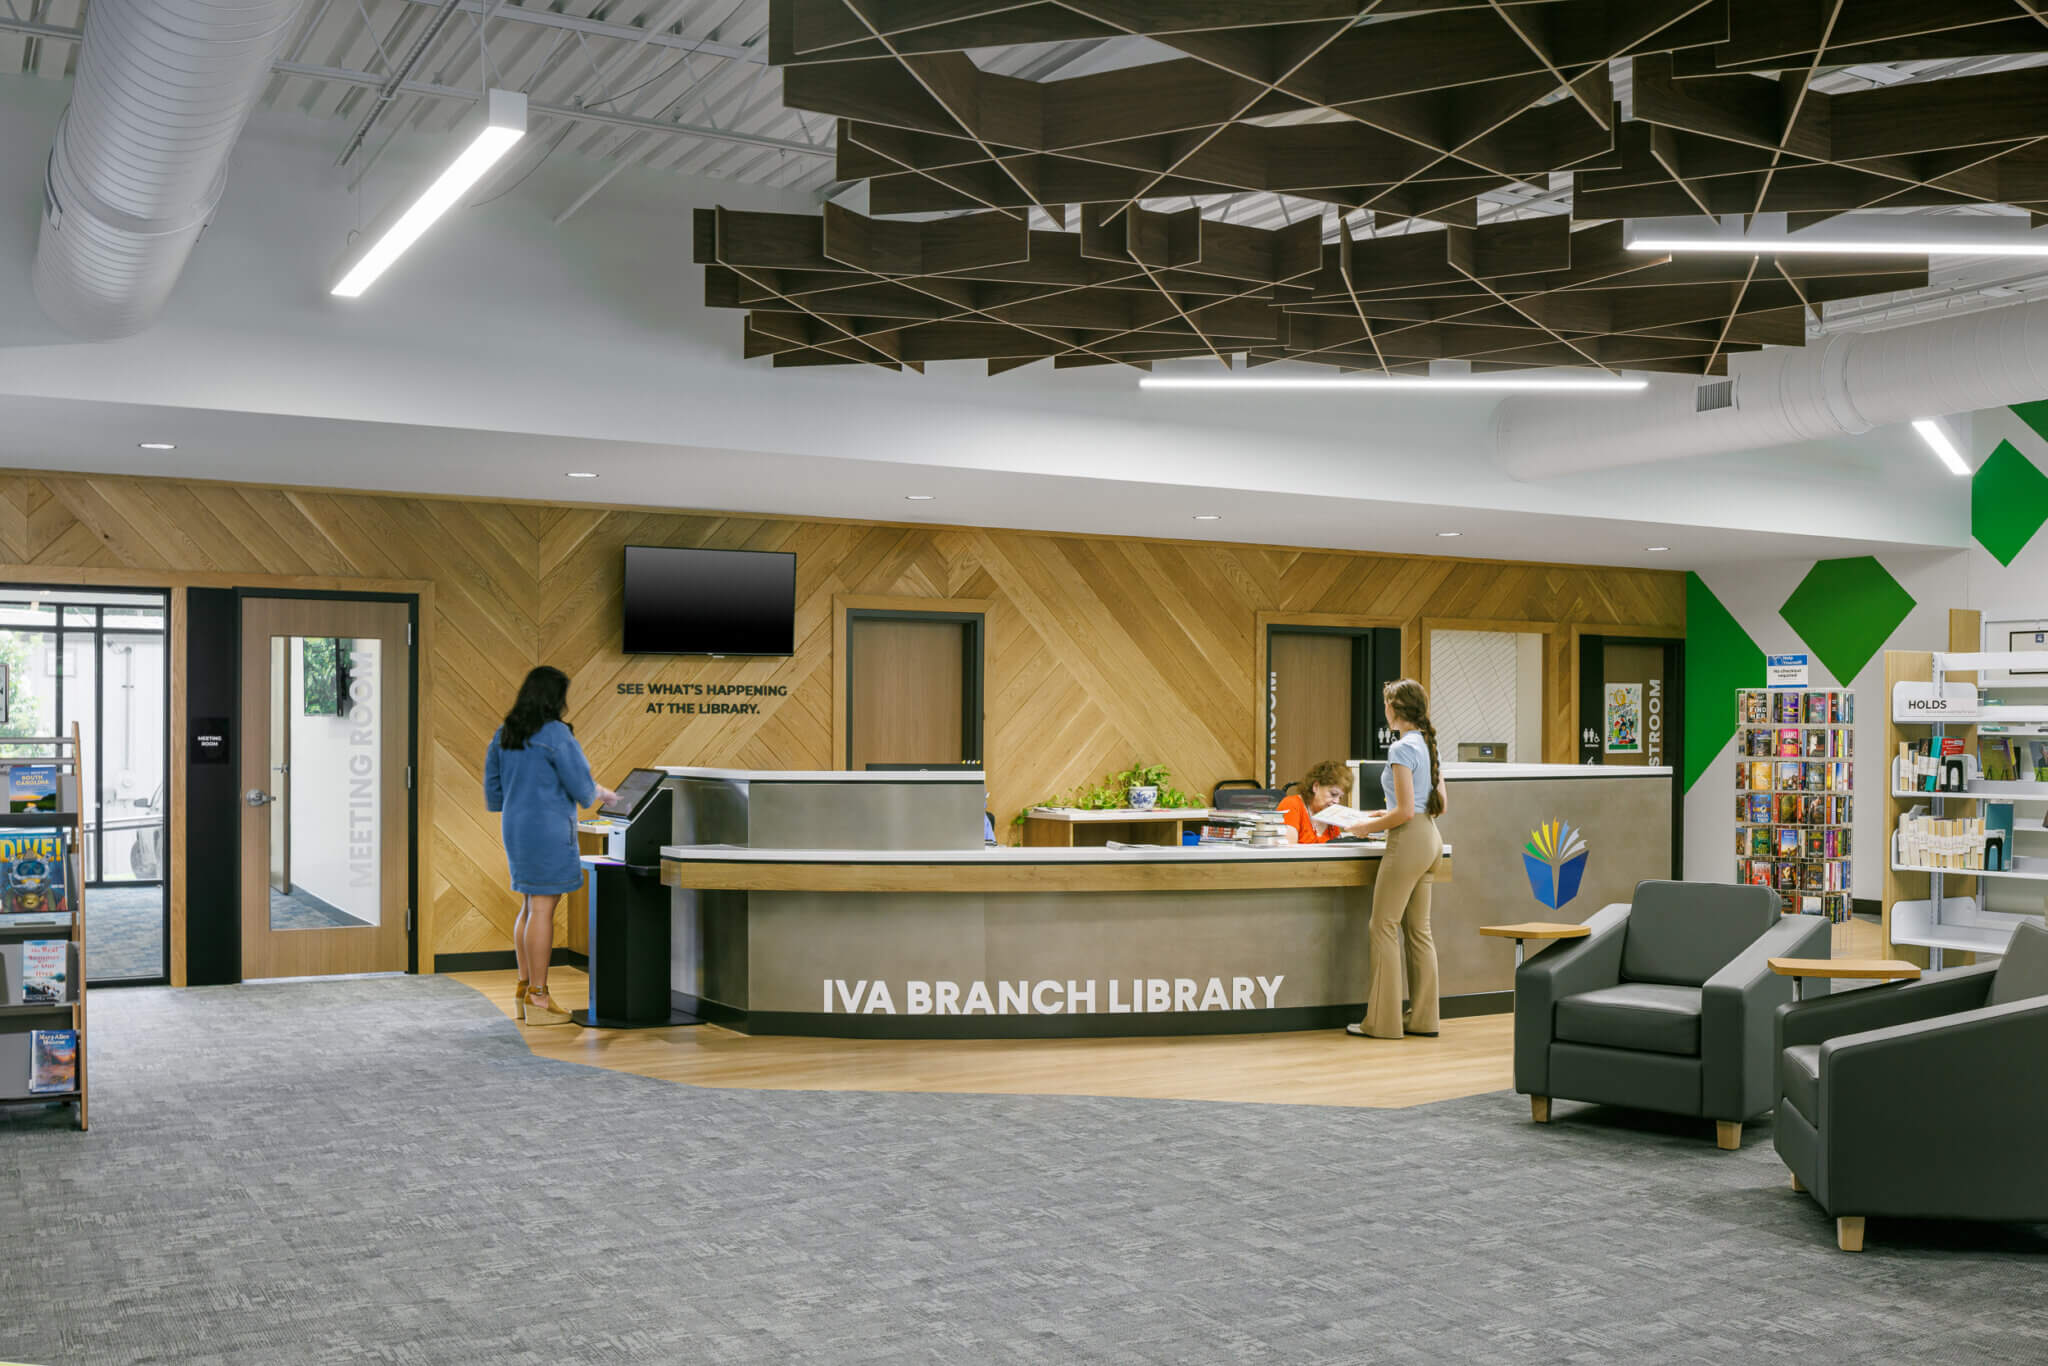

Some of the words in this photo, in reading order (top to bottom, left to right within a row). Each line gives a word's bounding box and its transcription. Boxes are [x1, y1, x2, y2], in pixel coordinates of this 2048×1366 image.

[349, 651, 373, 746] ROOM
[617, 683, 644, 695] SEE
[648, 683, 703, 696] WHAT'S
[706, 685, 788, 697] HAPPENING
[1908, 700, 1947, 710] HOLDS
[646, 703, 664, 714] AT
[669, 703, 695, 714] THE
[699, 703, 760, 715] LIBRARY.
[1648, 679, 1661, 767] STROOM
[349, 754, 373, 888] MEETING
[0, 838, 61, 862] DIVE!
[823, 979, 897, 1014] IVA
[906, 979, 1096, 1015] BRANCH
[1108, 975, 1286, 1013] LIBRARY
